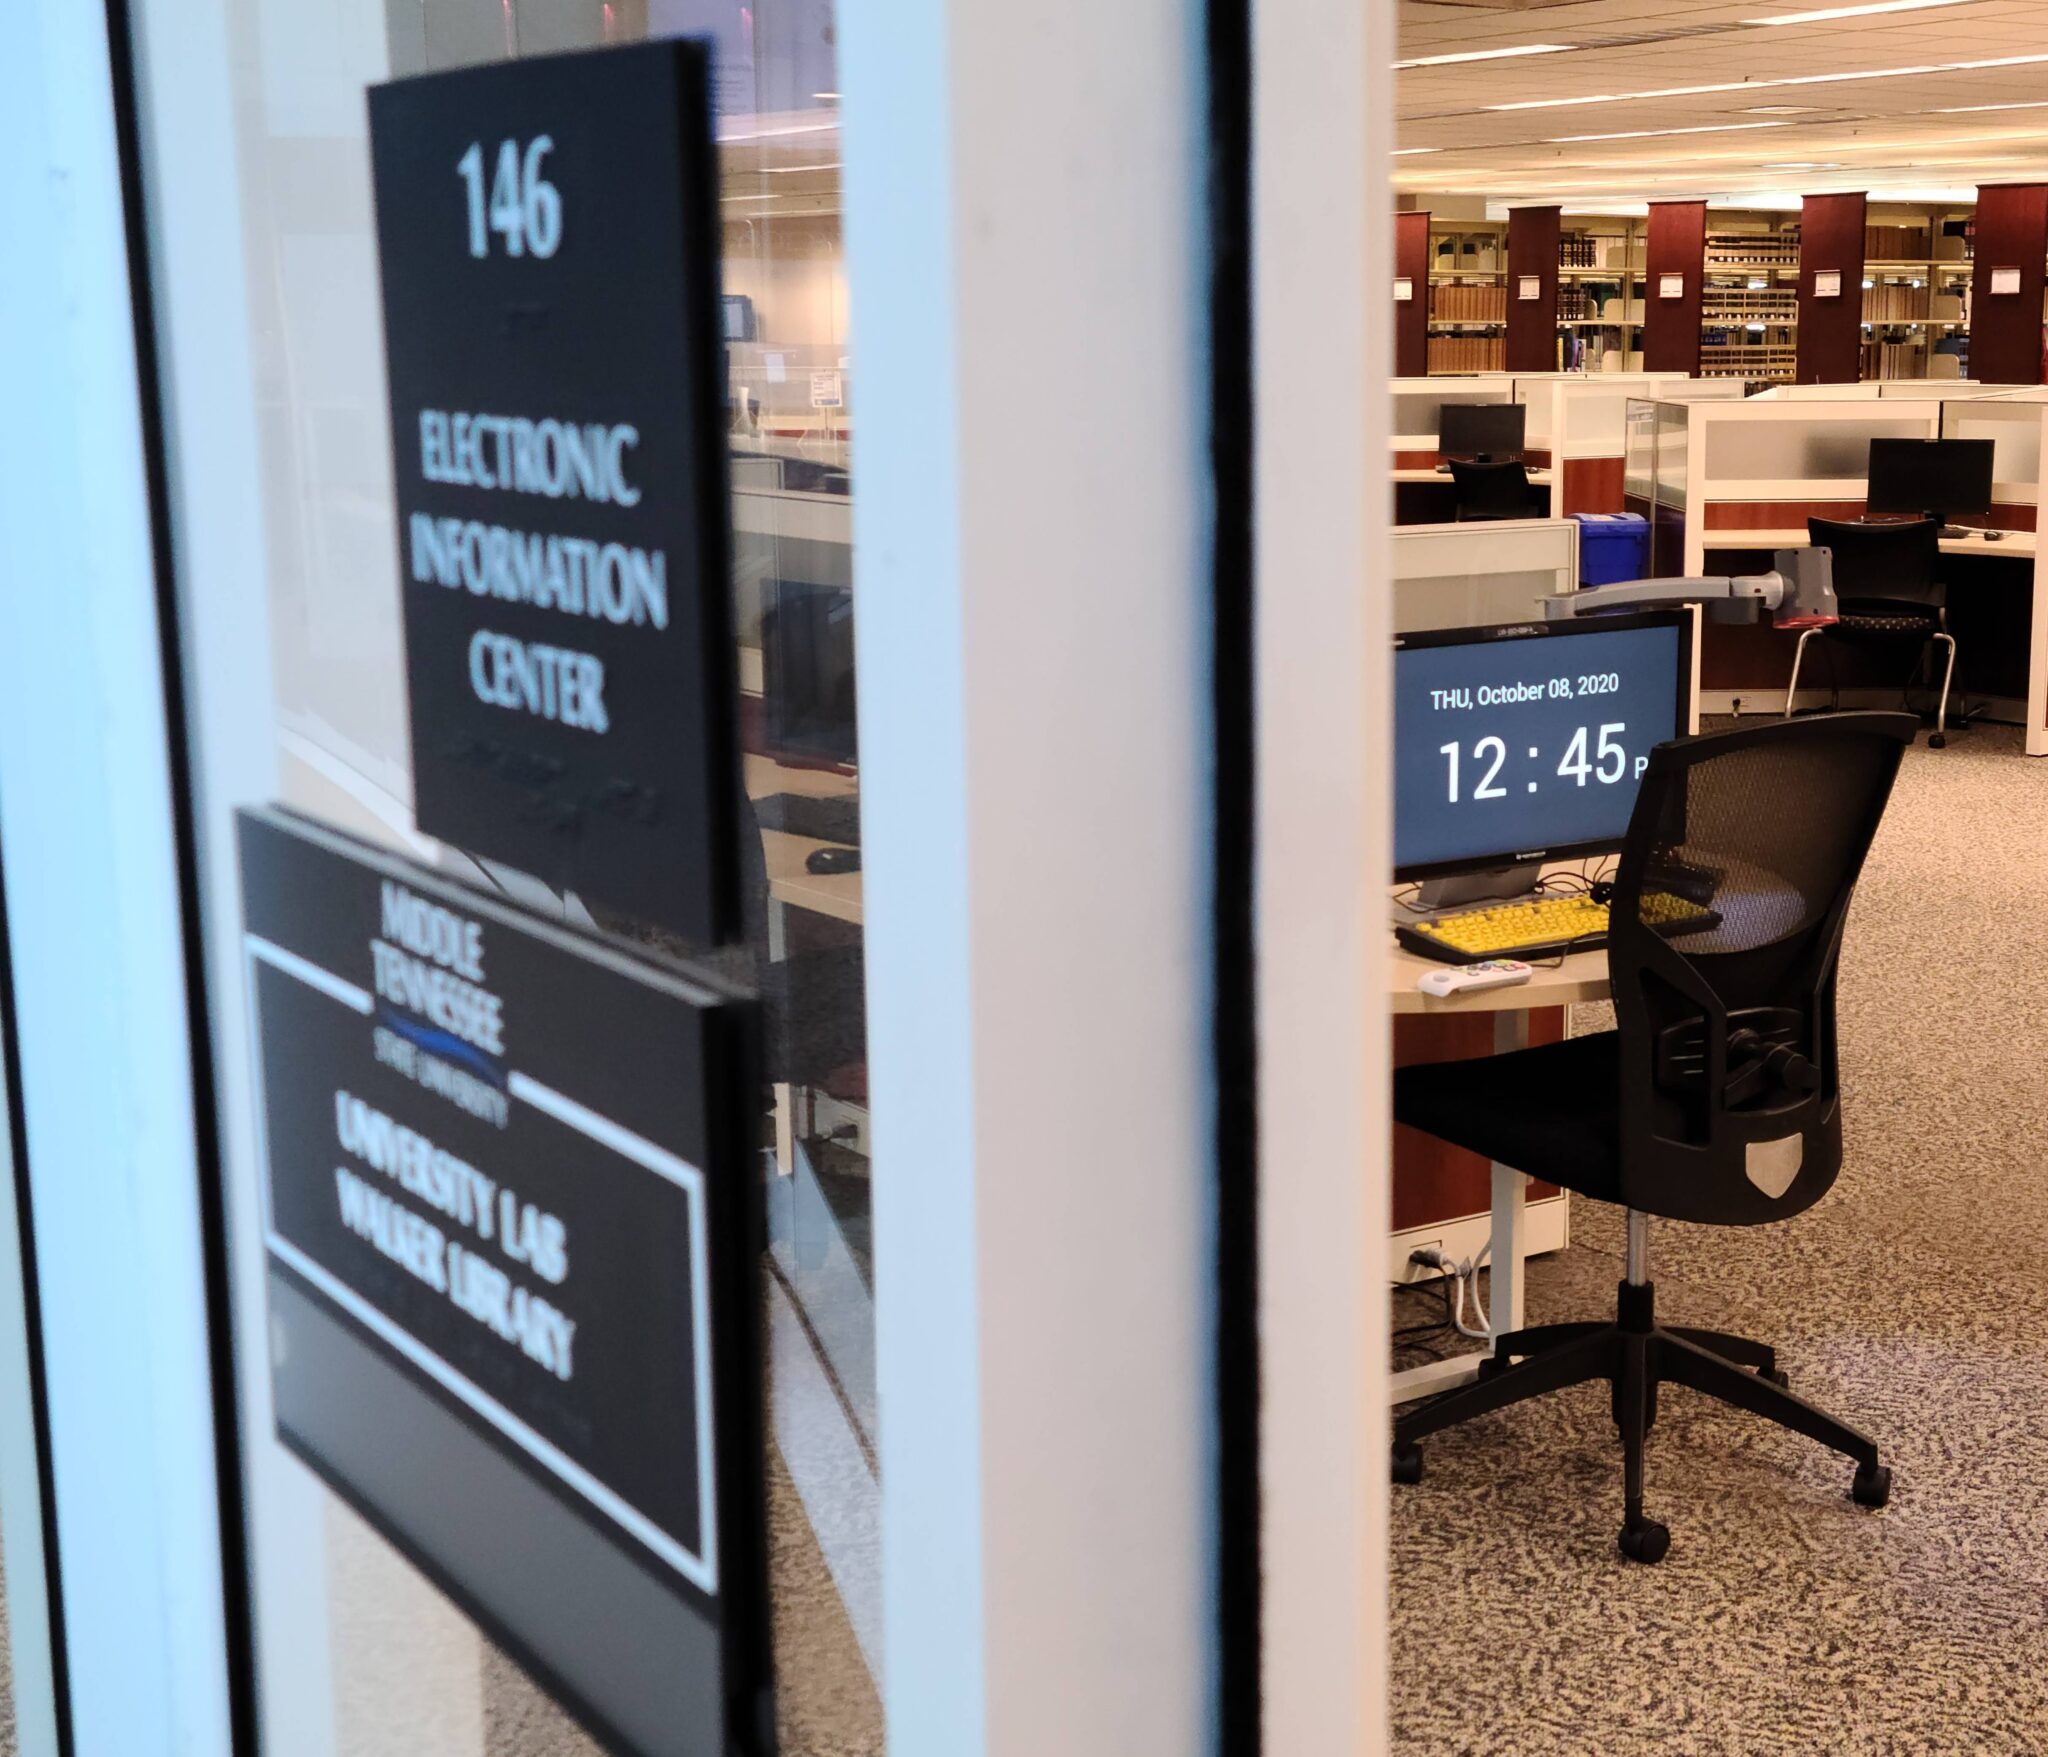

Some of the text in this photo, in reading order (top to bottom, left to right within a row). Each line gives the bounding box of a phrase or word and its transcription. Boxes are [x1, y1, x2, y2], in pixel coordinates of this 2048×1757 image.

[456, 134, 563, 259] 146
[419, 408, 641, 507] ELECTRONIC
[410, 511, 669, 630] INFORMATION
[469, 628, 610, 734] CENTER
[1430, 673, 1619, 710] THU, October 08, 2020
[1634, 757, 1650, 780] P
[381, 879, 486, 981] MIDDLE
[371, 938, 506, 1057] TENNESSEE
[417, 1051, 508, 1130] UNIVERSITY
[335, 1089, 568, 1284] UNIVERSITY LAB
[335, 1166, 576, 1382] WALKER LIBRARY
